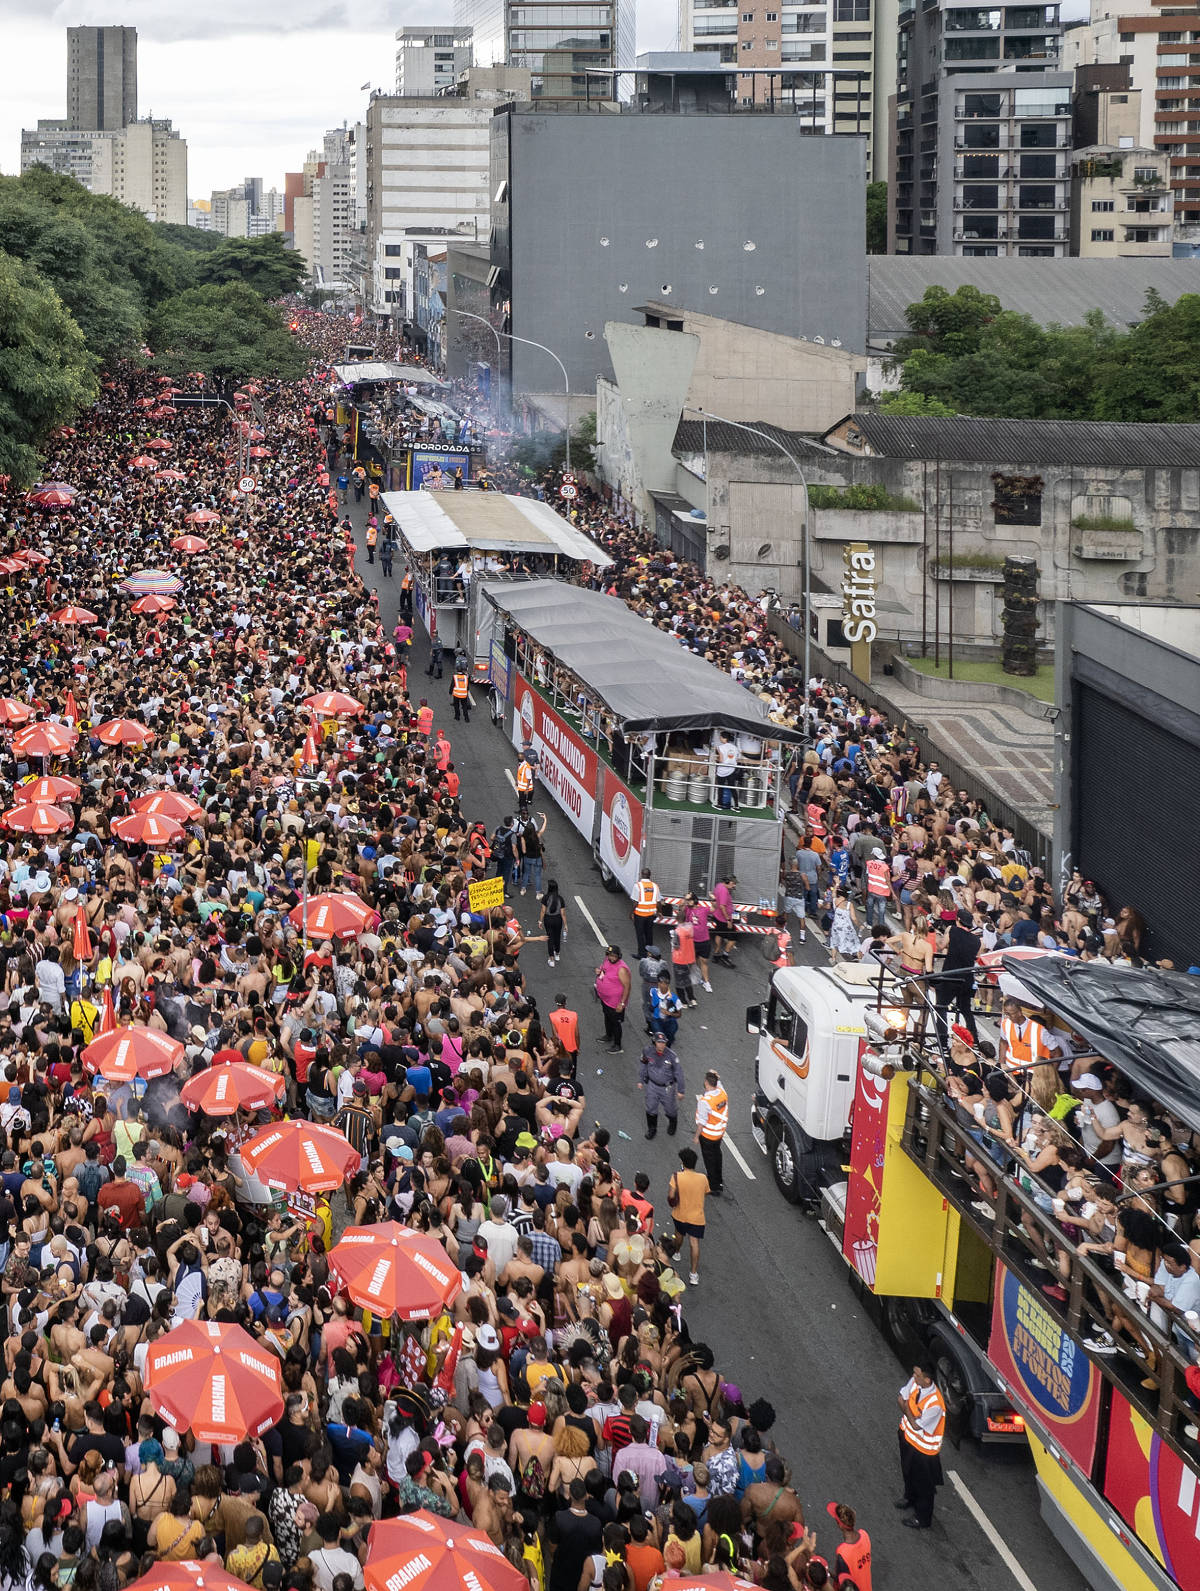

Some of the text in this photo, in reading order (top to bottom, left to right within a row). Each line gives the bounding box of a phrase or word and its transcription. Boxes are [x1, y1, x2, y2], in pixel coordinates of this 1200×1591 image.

[413, 442, 470, 453] BORDOADA
[242, 480, 254, 488] 50
[843, 551, 877, 643] Safra
[542, 711, 586, 779] TODO MUNDO
[544, 759, 582, 818] BEM-VINDO
[560, 1016, 570, 1024] 52
[251, 1133, 282, 1157] BRAHMA
[302, 1141, 324, 1174] BRAHMA
[368, 1259, 391, 1296] BRAHMA
[413, 1253, 449, 1286] BRAHMA
[155, 1349, 193, 1370] BRAHMA
[240, 1352, 276, 1381] BRAHMA
[1013, 1322, 1071, 1396] ATENTOS
[1013, 1334, 1021, 1357] E
[1021, 1346, 1070, 1413] FORTES
[212, 1375, 225, 1423] BRAHMA
[386, 1554, 431, 1591] BRAHMA
